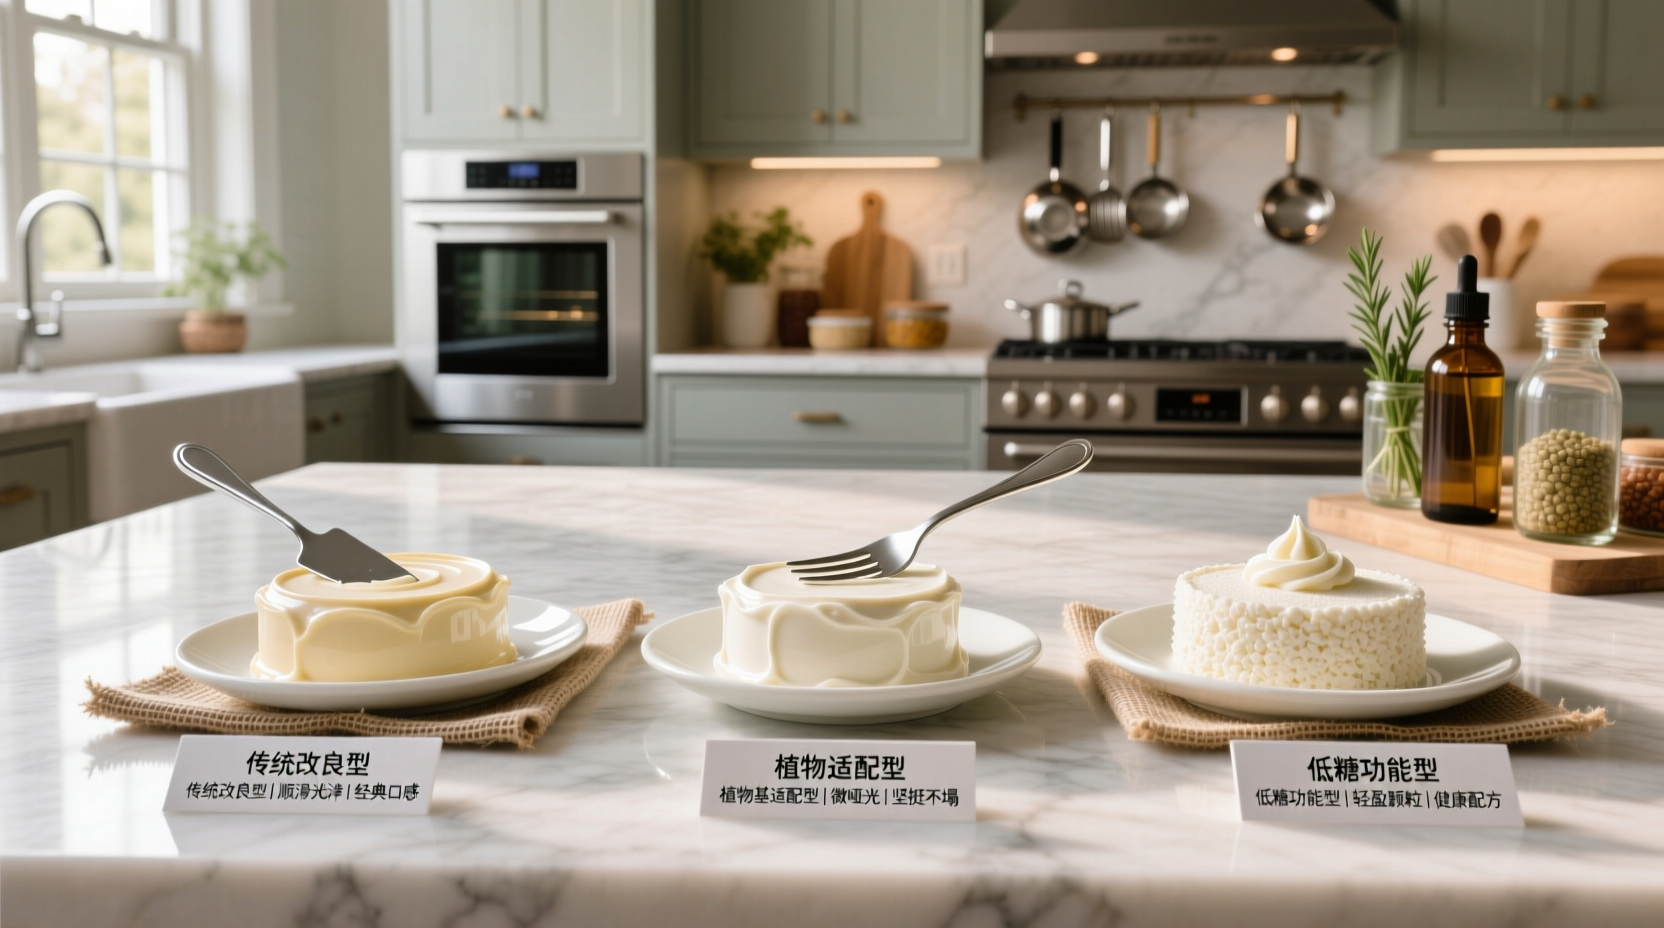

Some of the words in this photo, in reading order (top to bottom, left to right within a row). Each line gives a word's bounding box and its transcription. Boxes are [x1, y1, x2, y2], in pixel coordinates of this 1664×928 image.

[246, 750, 370, 776] 传统改良型
[774, 753, 905, 780] 植物适配型
[1307, 755, 1440, 782] 低糖功能型
[186, 781, 267, 800] 传统改良型
[719, 785, 820, 805] 植物基适配型
[1256, 788, 1341, 807] 低糖功能型
[1434, 790, 1502, 809] 健康配方
